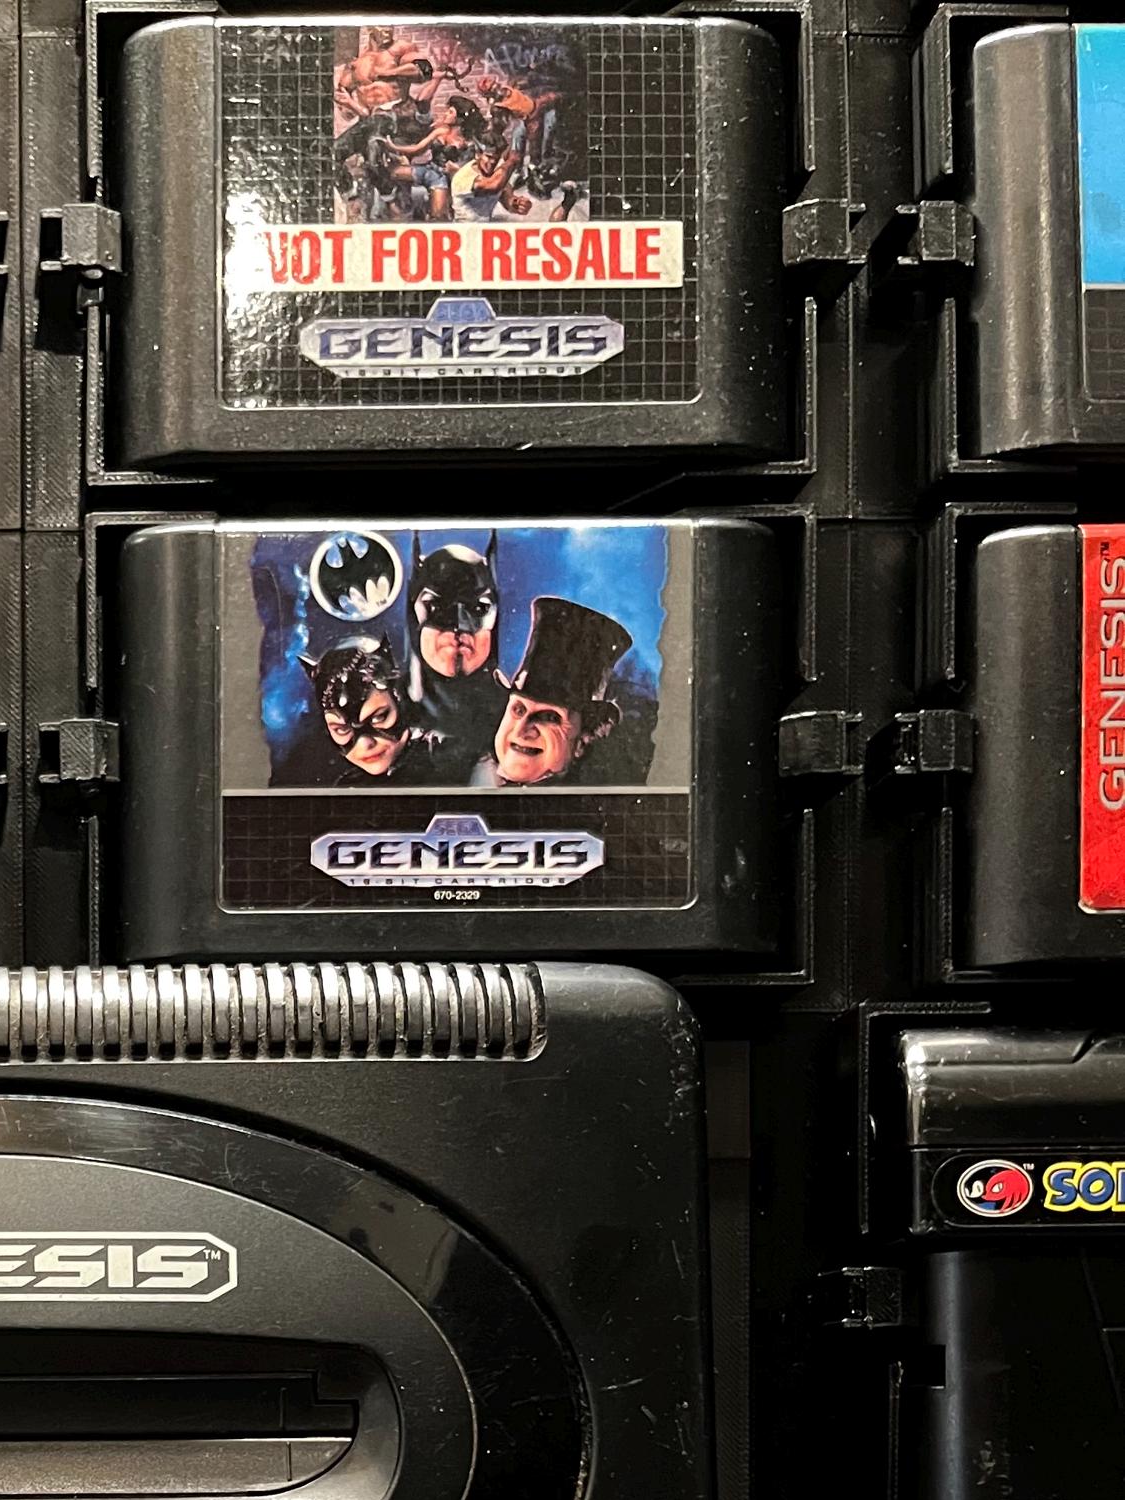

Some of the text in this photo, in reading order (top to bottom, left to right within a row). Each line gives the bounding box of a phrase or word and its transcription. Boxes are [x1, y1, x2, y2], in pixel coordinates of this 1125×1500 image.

[371, 229, 464, 284] FOR
[481, 227, 662, 282] RESALE
[318, 326, 608, 361] GENESIS
[327, 840, 589, 870] GENESIS
[435, 876, 565, 885] CARTRIDGE
[1042, 1161, 1125, 1212] SO
